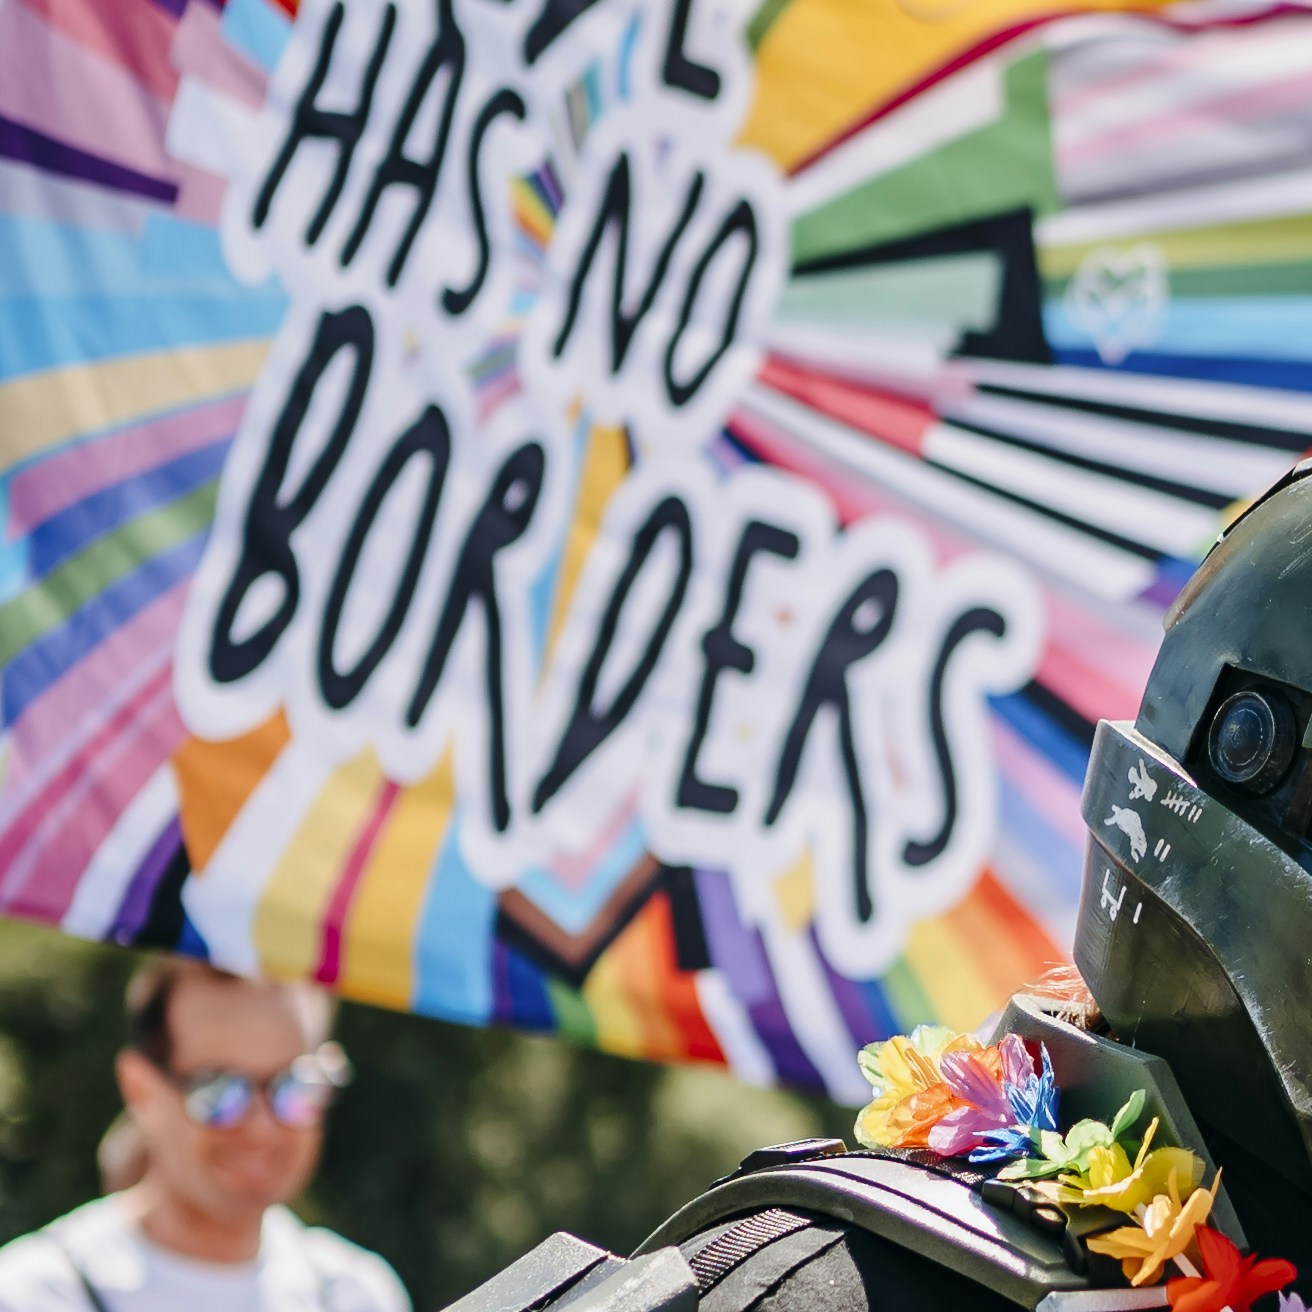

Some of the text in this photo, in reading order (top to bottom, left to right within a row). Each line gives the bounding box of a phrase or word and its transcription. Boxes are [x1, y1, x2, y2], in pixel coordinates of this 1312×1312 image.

[252, 0, 760, 408] HAS NO
[209, 306, 1007, 923] BORDERS
